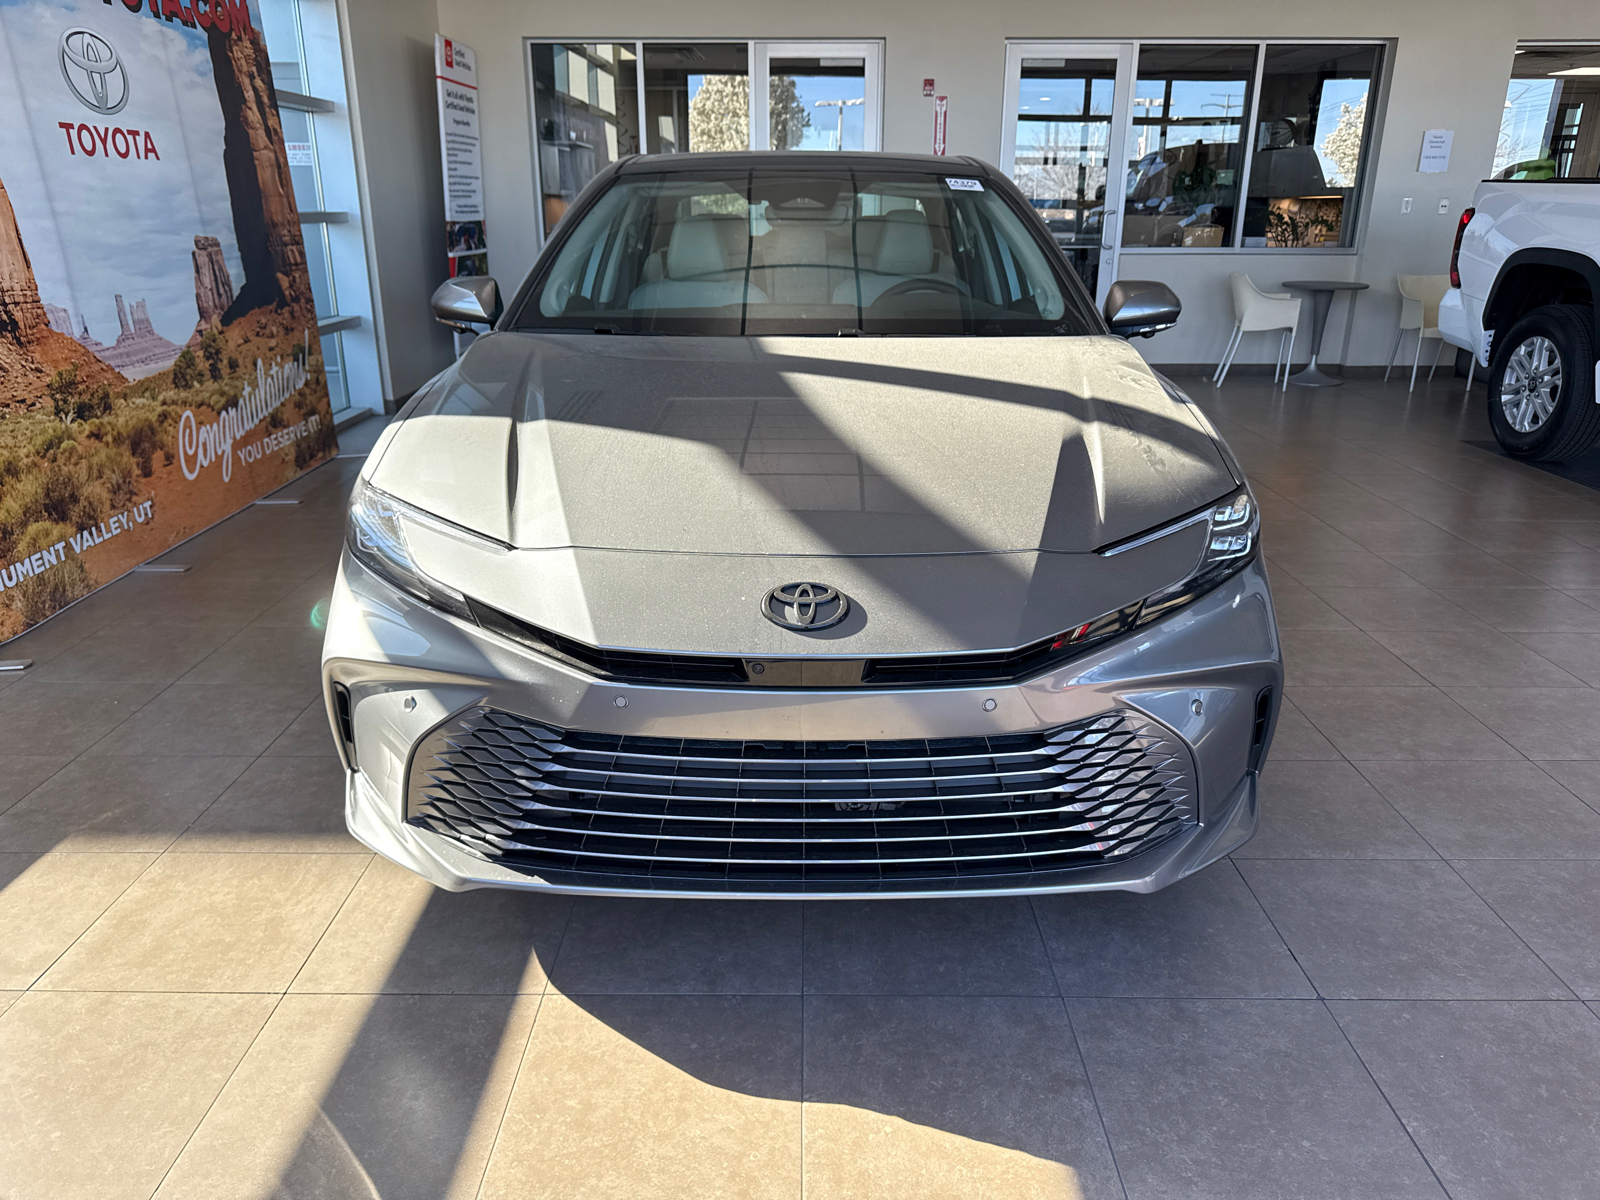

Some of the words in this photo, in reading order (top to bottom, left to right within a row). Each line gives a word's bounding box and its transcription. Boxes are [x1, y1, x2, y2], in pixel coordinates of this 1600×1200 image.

[58, 122, 160, 161] TOYOTA
[179, 329, 311, 482] Congratulations!
[238, 442, 262, 466] YOU
[263, 420, 308, 455] DESERVE
[308, 414, 321, 433] IT!
[69, 511, 133, 554] VALLEY,
[133, 500, 153, 523] UT
